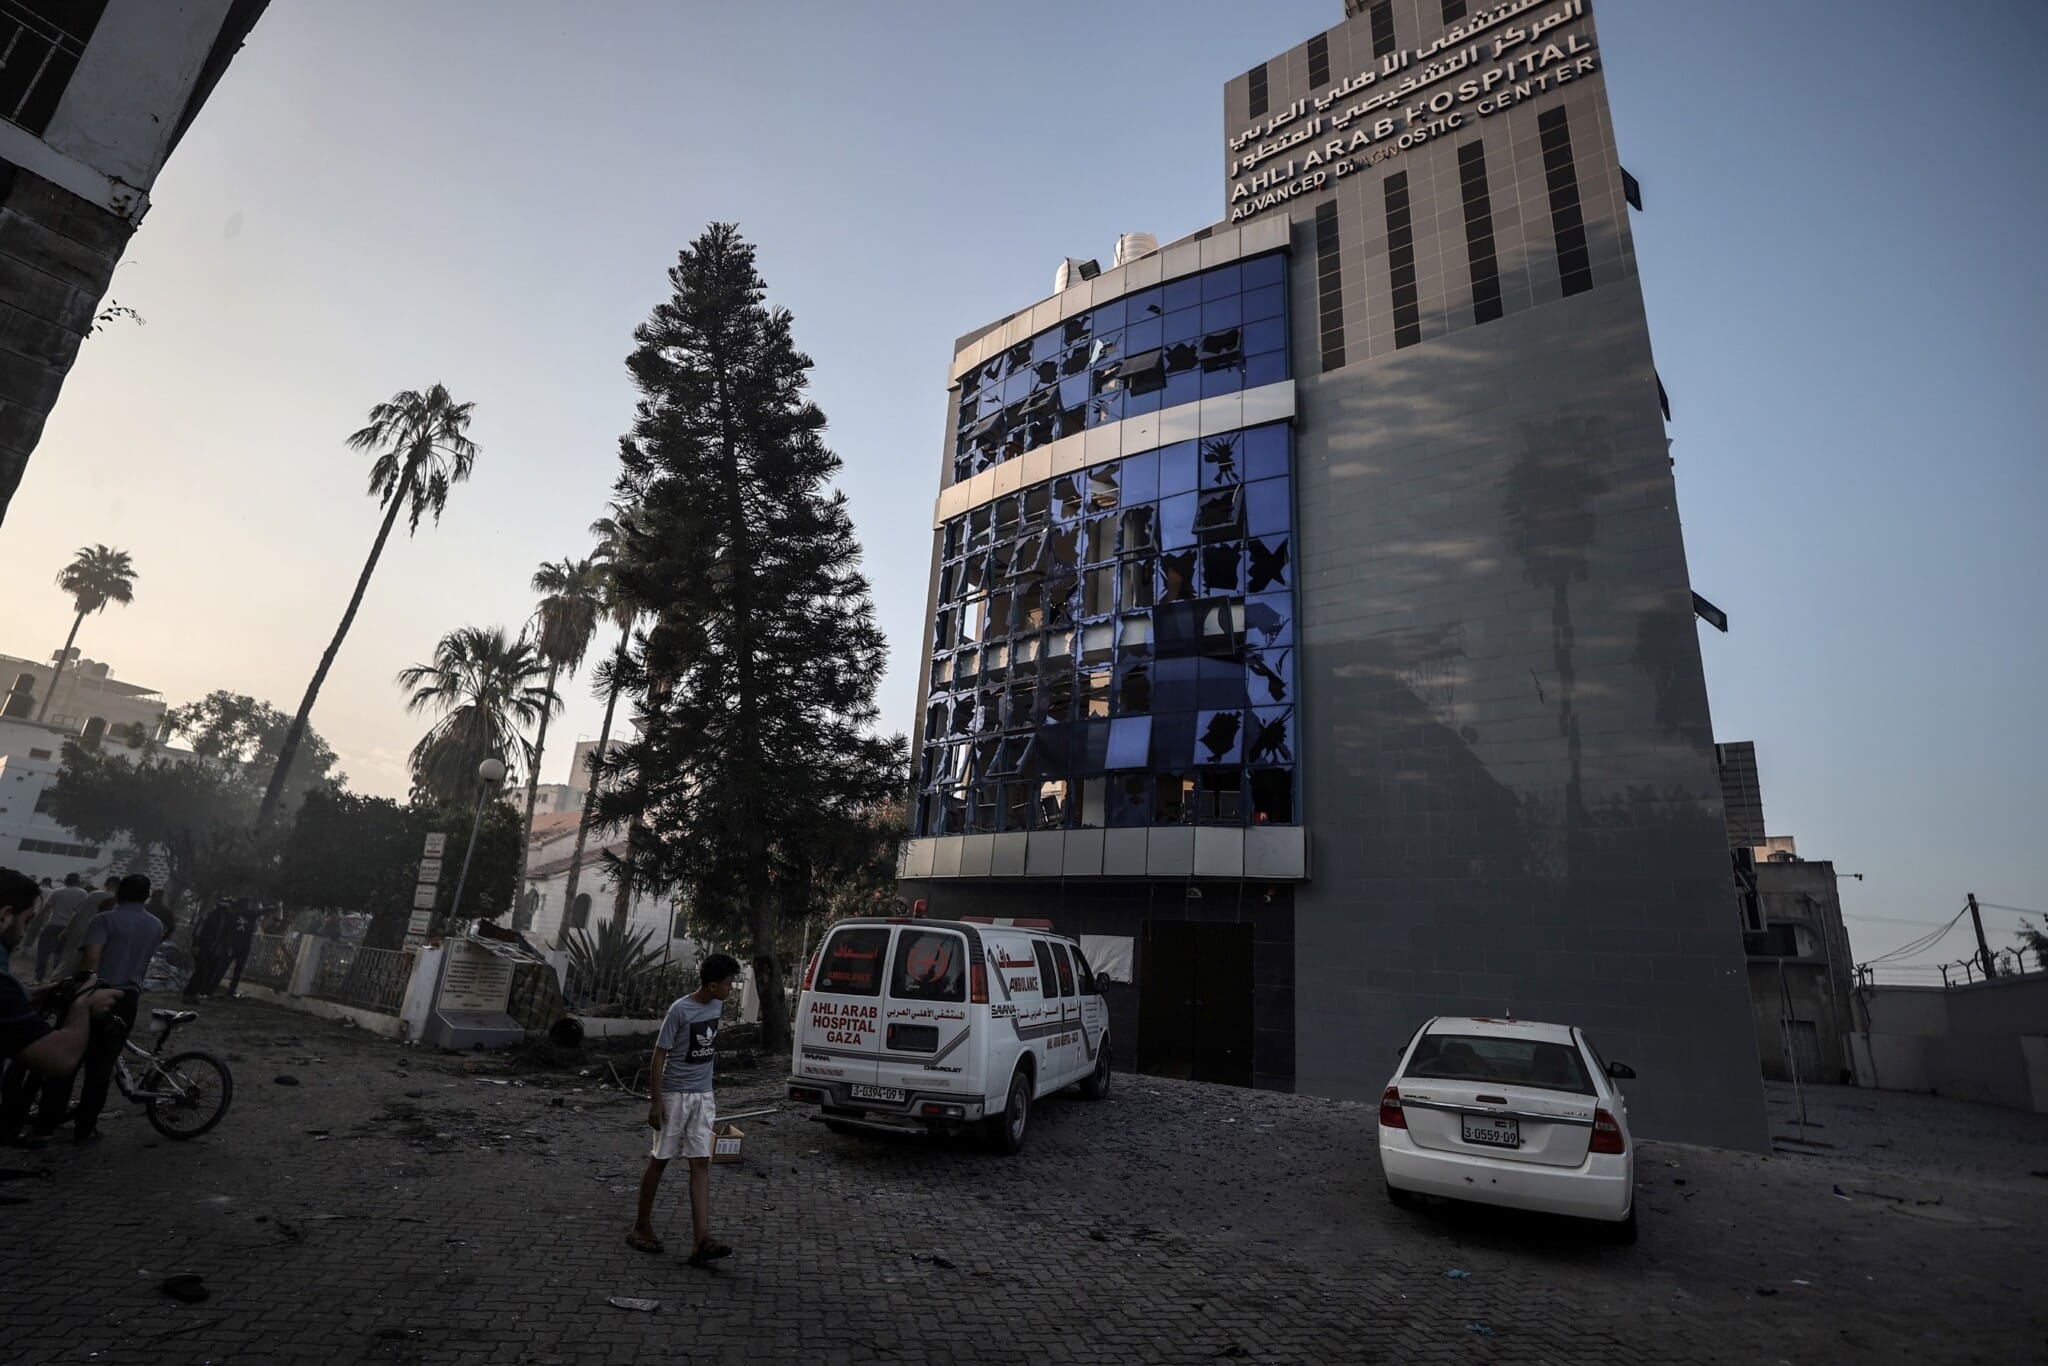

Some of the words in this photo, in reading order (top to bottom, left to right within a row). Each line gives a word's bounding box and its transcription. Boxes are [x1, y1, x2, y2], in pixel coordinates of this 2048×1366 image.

[1493, 0, 1582, 59] المركز
[1331, 45, 1478, 130] التشخيصي
[1229, 98, 1305, 150] العربي
[1231, 171, 1327, 223] ADVANCED
[1477, 56, 1595, 116] CENTER
[1230, 117, 1322, 178] المتطور
[1231, 160, 1294, 203] AHLI
[1303, 117, 1395, 171] ARAB
[1009, 976, 1039, 993] AMBULANCE
[810, 1002, 837, 1015] AHLI
[841, 1004, 878, 1018] ARAB
[812, 1015, 876, 1033] HOSPITAL
[991, 1004, 1016, 1015] SAVANA
[826, 1031, 862, 1045] GAZA
[1464, 1127, 1517, 1144] 3-0559-09
